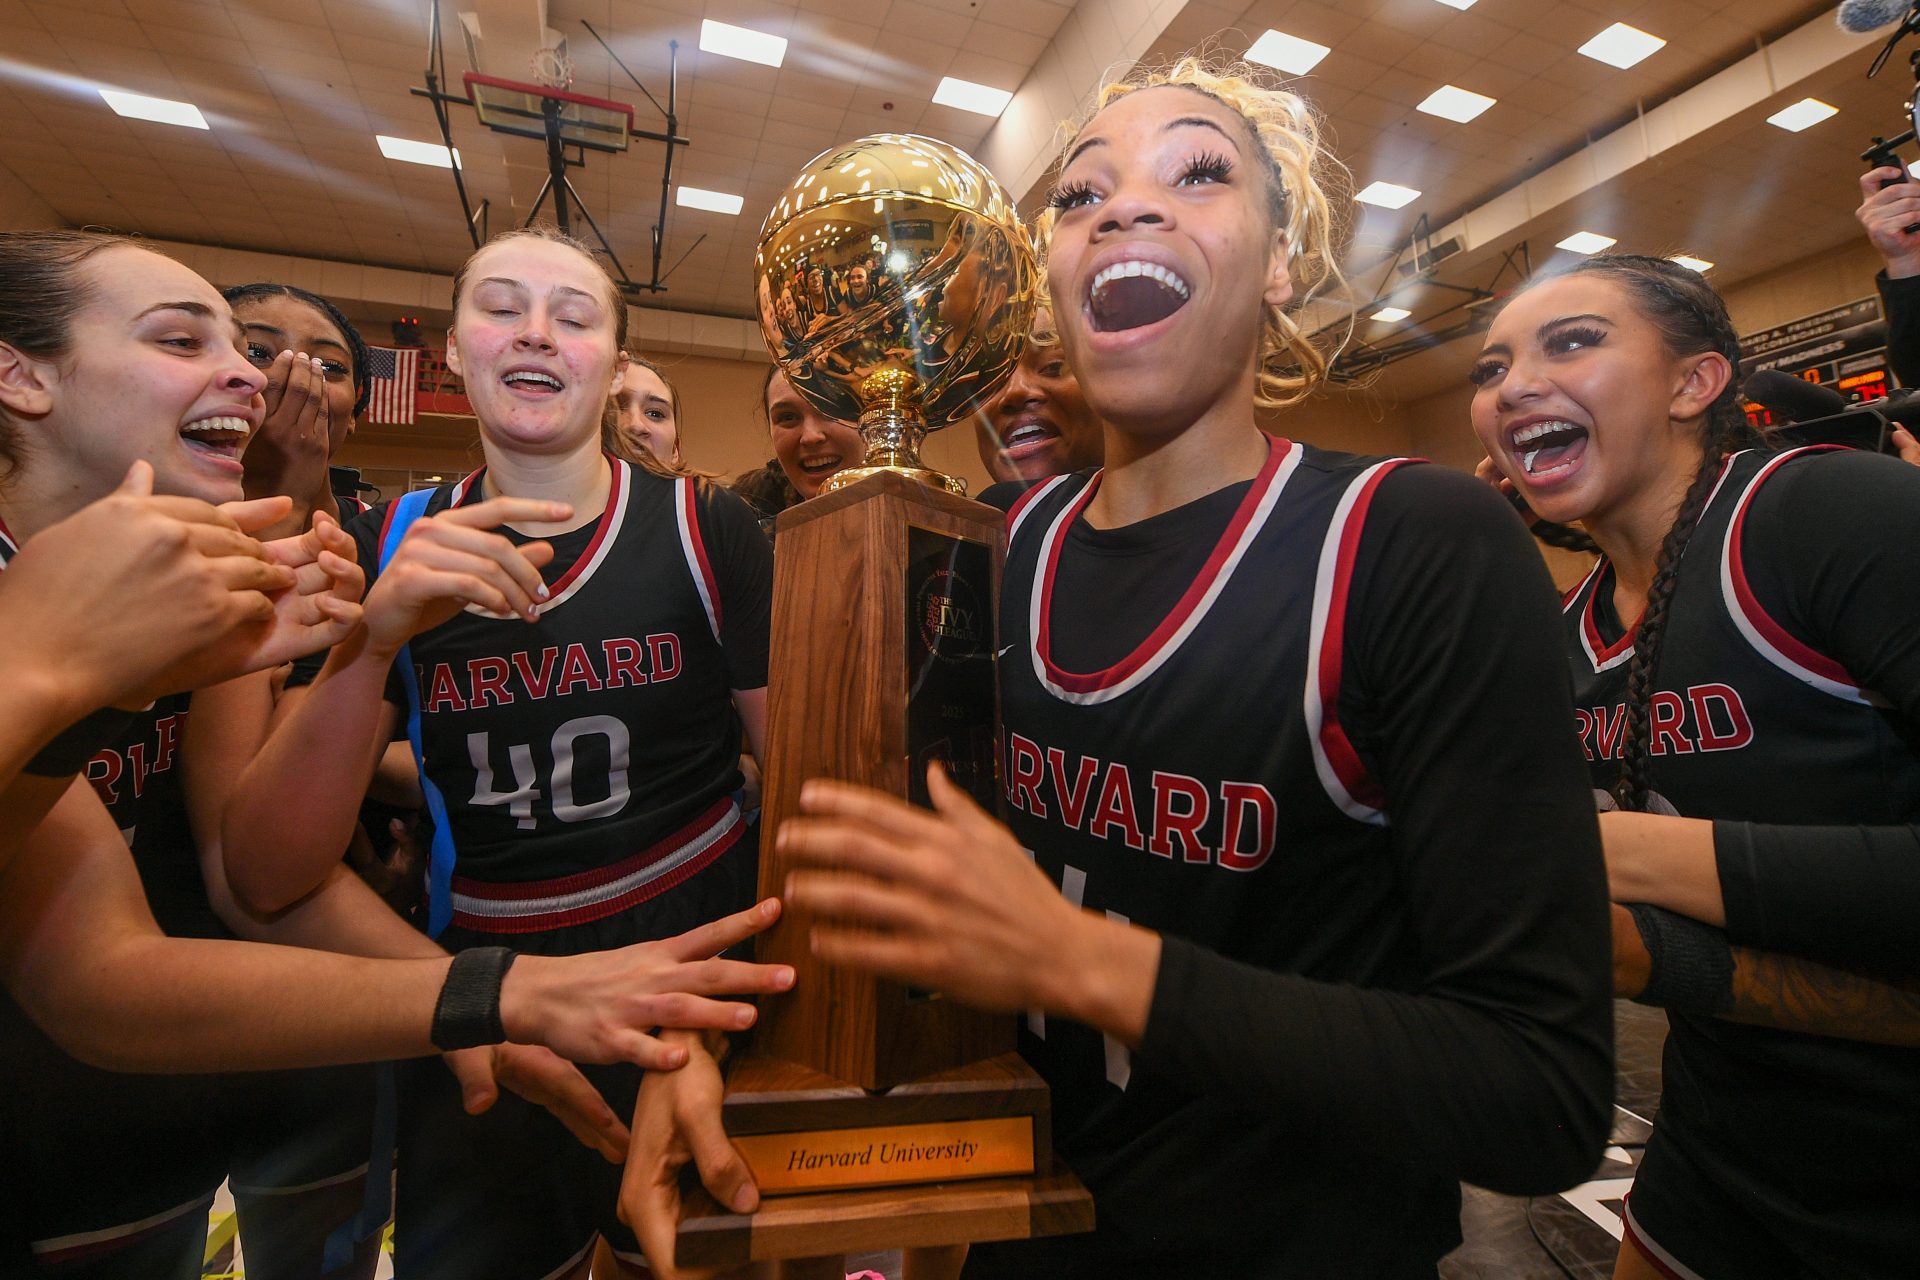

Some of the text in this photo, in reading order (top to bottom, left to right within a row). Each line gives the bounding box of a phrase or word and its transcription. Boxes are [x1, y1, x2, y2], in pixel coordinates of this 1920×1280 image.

[939, 605, 974, 630] IVY
[467, 714, 632, 830] 40
[1001, 723, 1278, 873] RVARD
[787, 1138, 979, 1172] Harvard University
